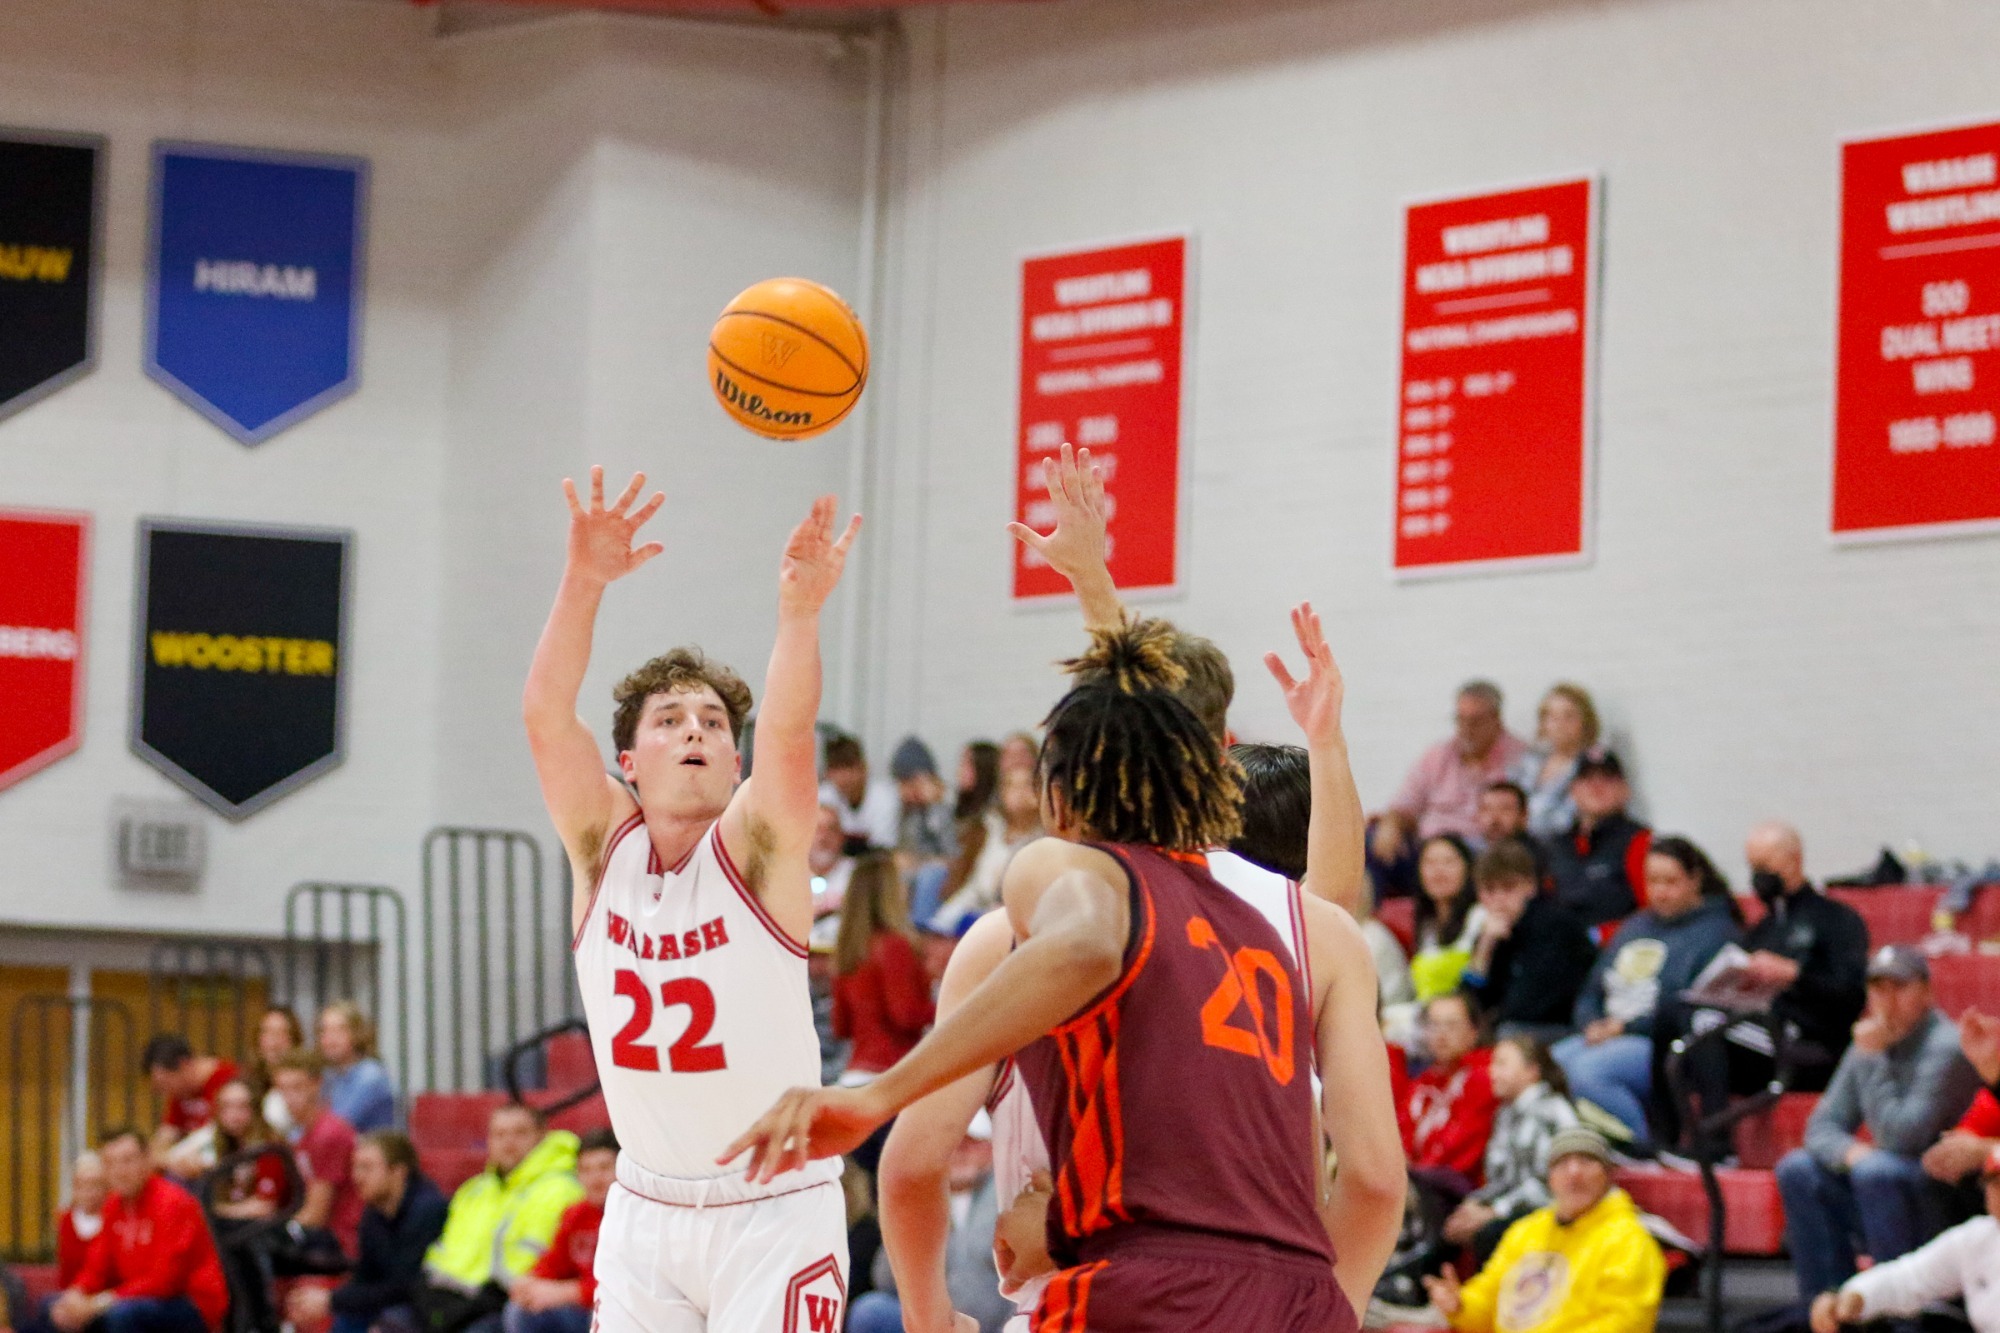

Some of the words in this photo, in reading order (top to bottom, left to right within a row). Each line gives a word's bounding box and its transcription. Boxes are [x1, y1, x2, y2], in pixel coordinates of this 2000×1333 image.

[194, 257, 317, 300] HIRAM
[717, 367, 812, 425] Wilson
[151, 631, 335, 676] WOOSTER
[612, 969, 728, 1073] 22
[1186, 916, 1295, 1087] 20
[805, 1294, 838, 1333] W
